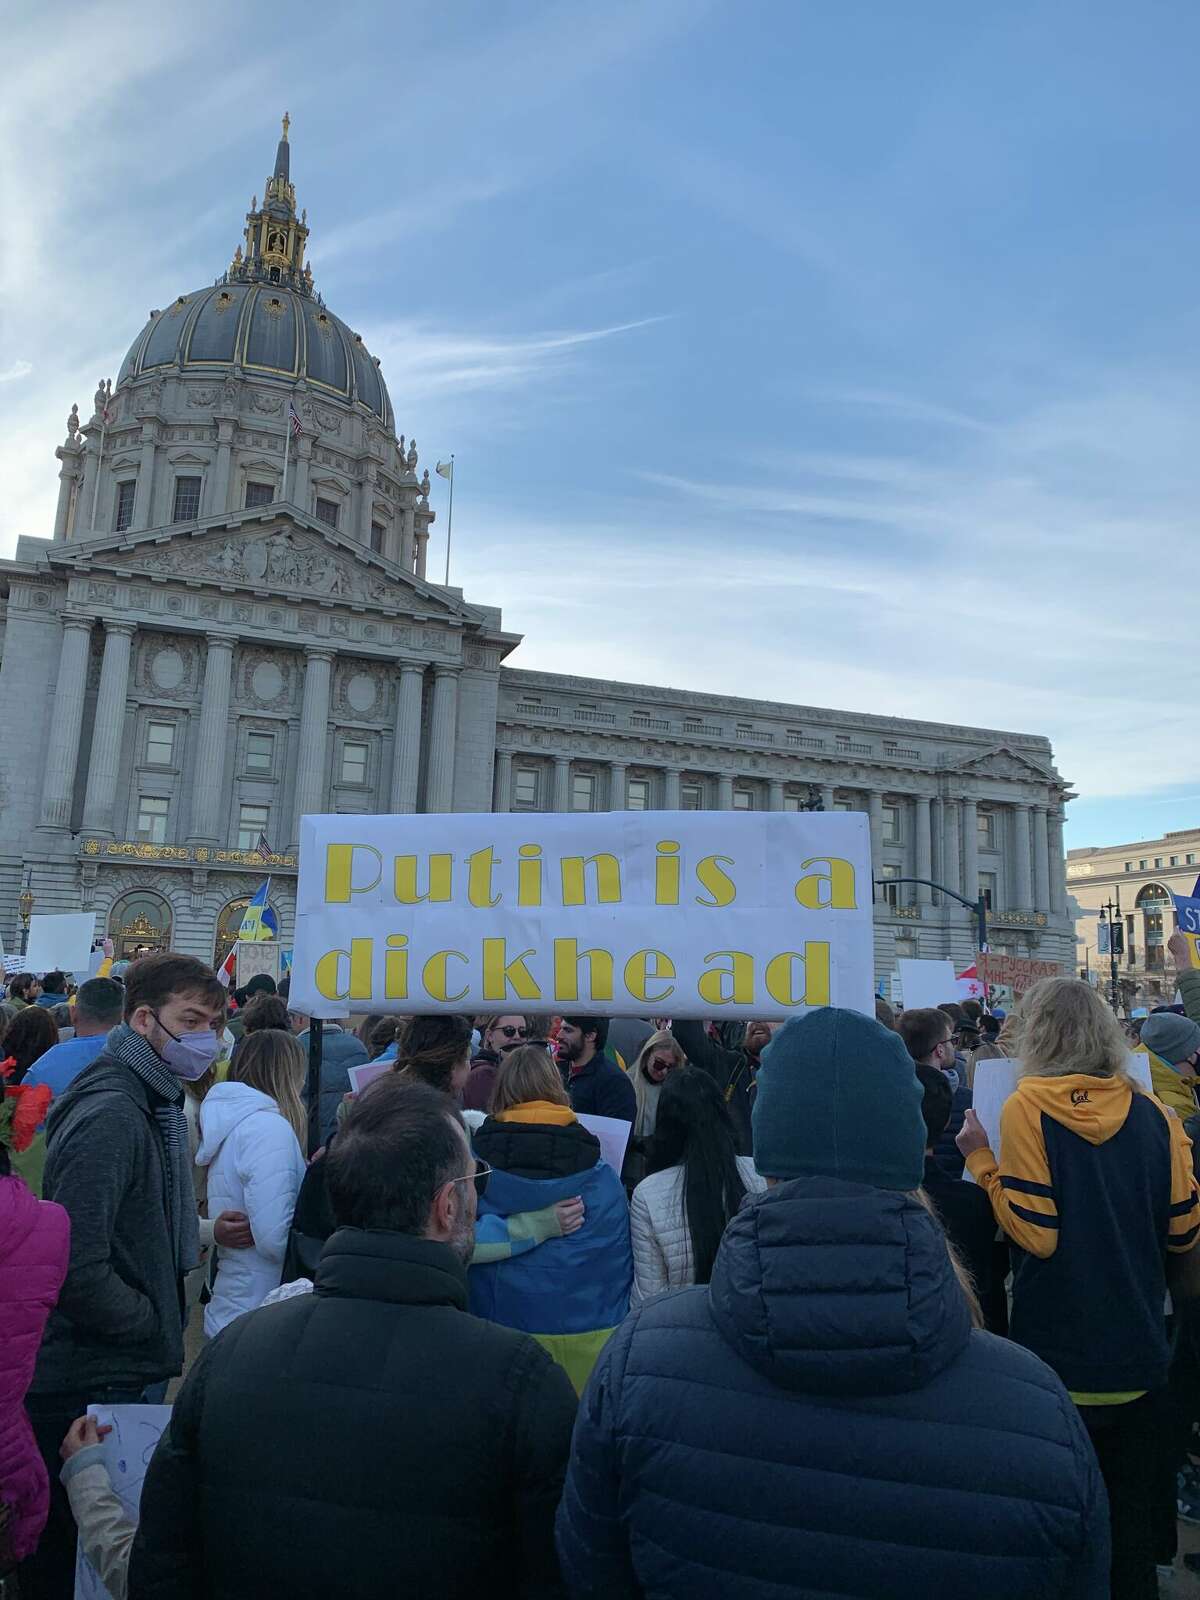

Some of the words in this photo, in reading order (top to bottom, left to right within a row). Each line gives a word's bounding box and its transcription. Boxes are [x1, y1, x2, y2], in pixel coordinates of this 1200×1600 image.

[324, 843, 623, 908] Putin
[655, 840, 737, 907] is
[794, 856, 859, 910] a
[315, 934, 831, 1006] dickhead
[1071, 1088, 1090, 1106] Cal
